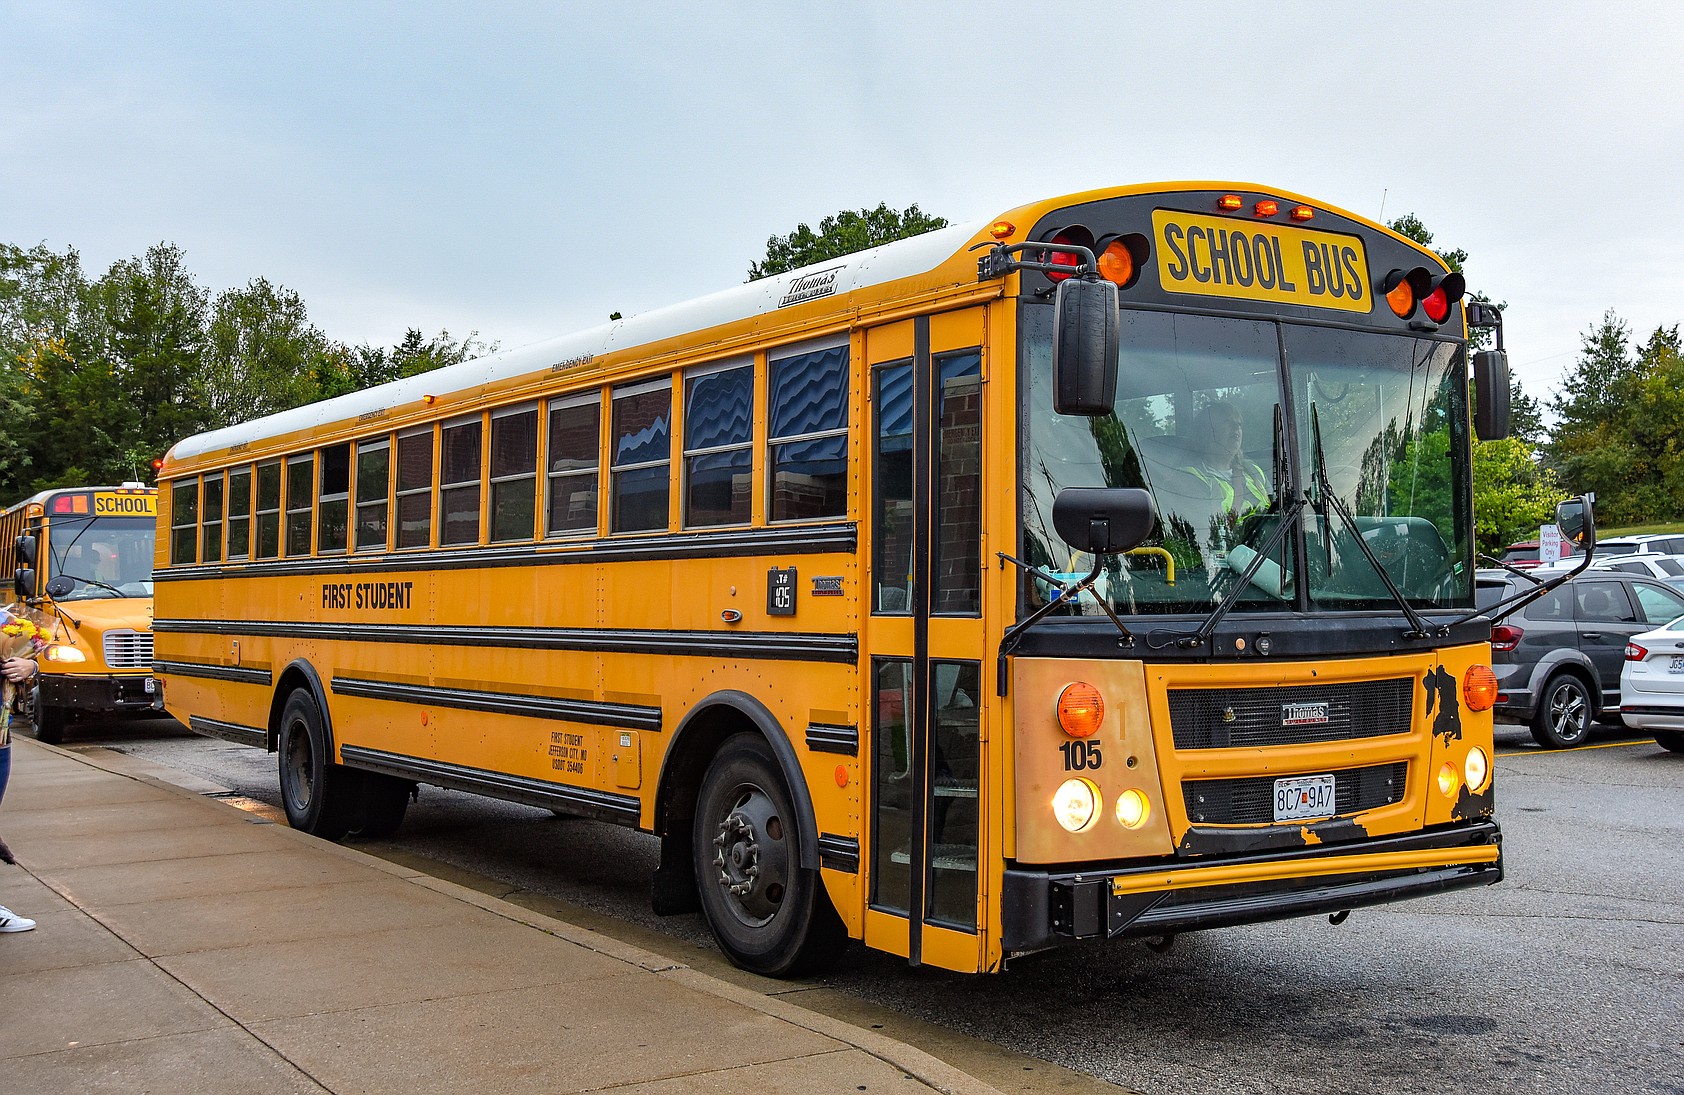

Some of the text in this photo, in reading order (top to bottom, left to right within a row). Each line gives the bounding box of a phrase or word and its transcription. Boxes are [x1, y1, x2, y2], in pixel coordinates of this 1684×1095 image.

[1164, 223, 1363, 301] SCHOOL BUS
[788, 264, 848, 295] Thomas
[551, 354, 594, 373] EMERGENCY EXIT
[96, 497, 153, 513] SCHOOL
[1541, 540, 1559, 548] Parking
[1544, 548, 1555, 556] Only
[322, 581, 413, 609] FIRST STUDENT
[1282, 702, 1329, 720] Thomas
[550, 731, 583, 747] FIRST STUDENT
[548, 744, 568, 758] JEFFERSON
[580, 749, 587, 761] MO
[1059, 740, 1102, 771] 105
[552, 758, 565, 771] USDOT
[1277, 785, 1333, 811] 8C7 9A7
